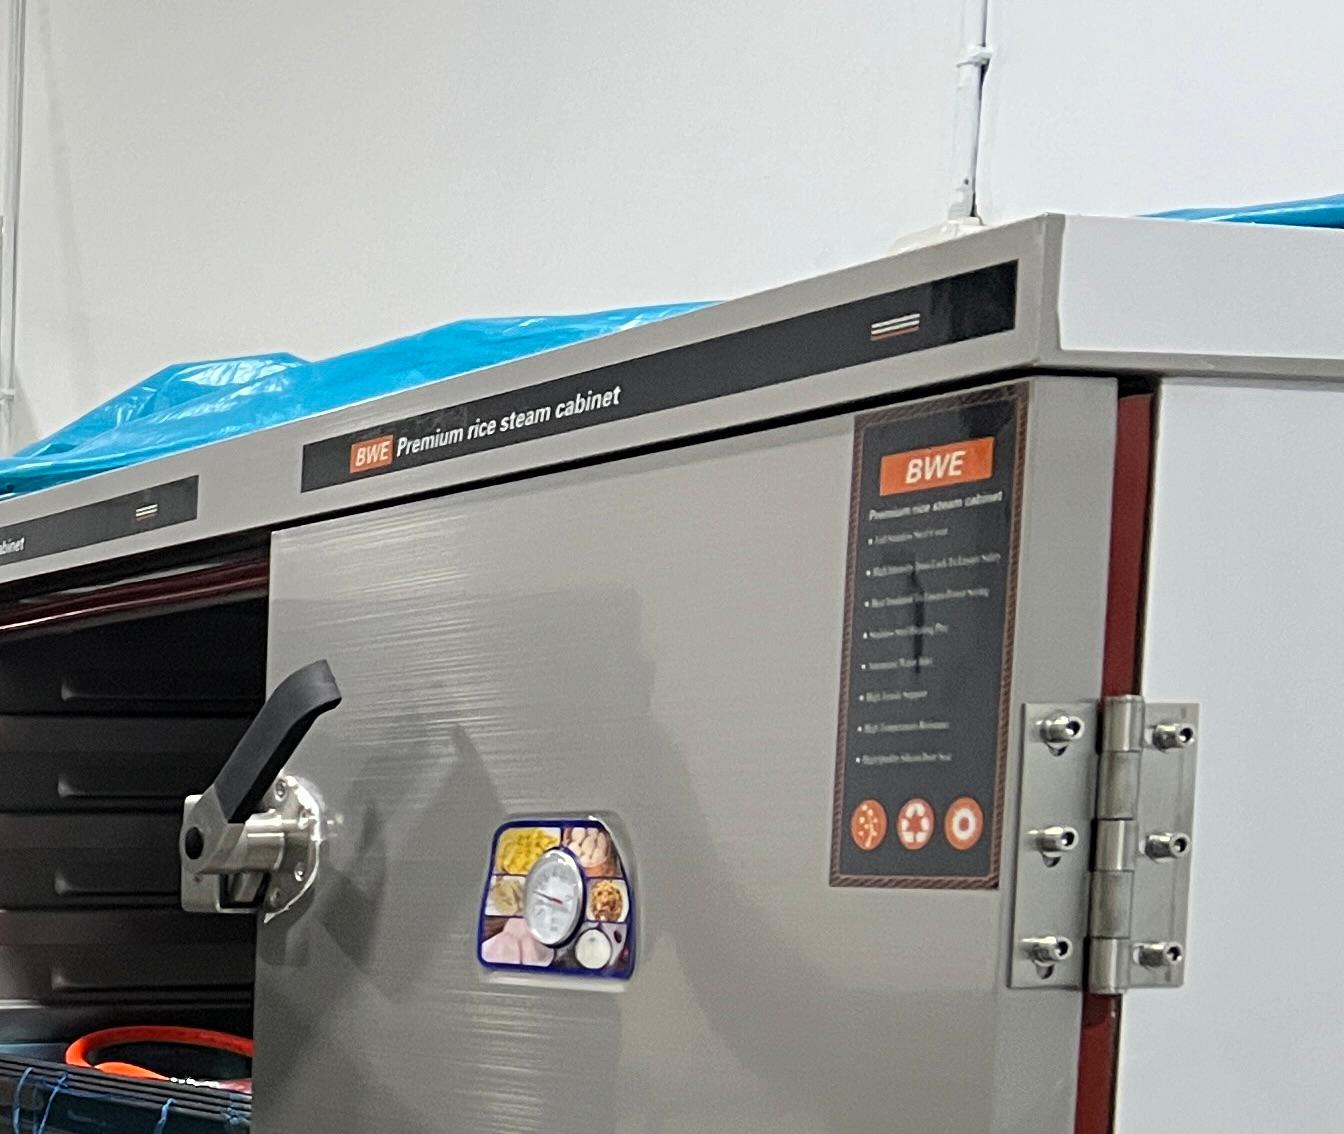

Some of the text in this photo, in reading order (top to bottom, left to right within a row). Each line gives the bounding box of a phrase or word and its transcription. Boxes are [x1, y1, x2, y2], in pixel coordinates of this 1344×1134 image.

[355, 385, 621, 467] BWE Premium rice steam cabinet
[905, 451, 966, 484] BWE
